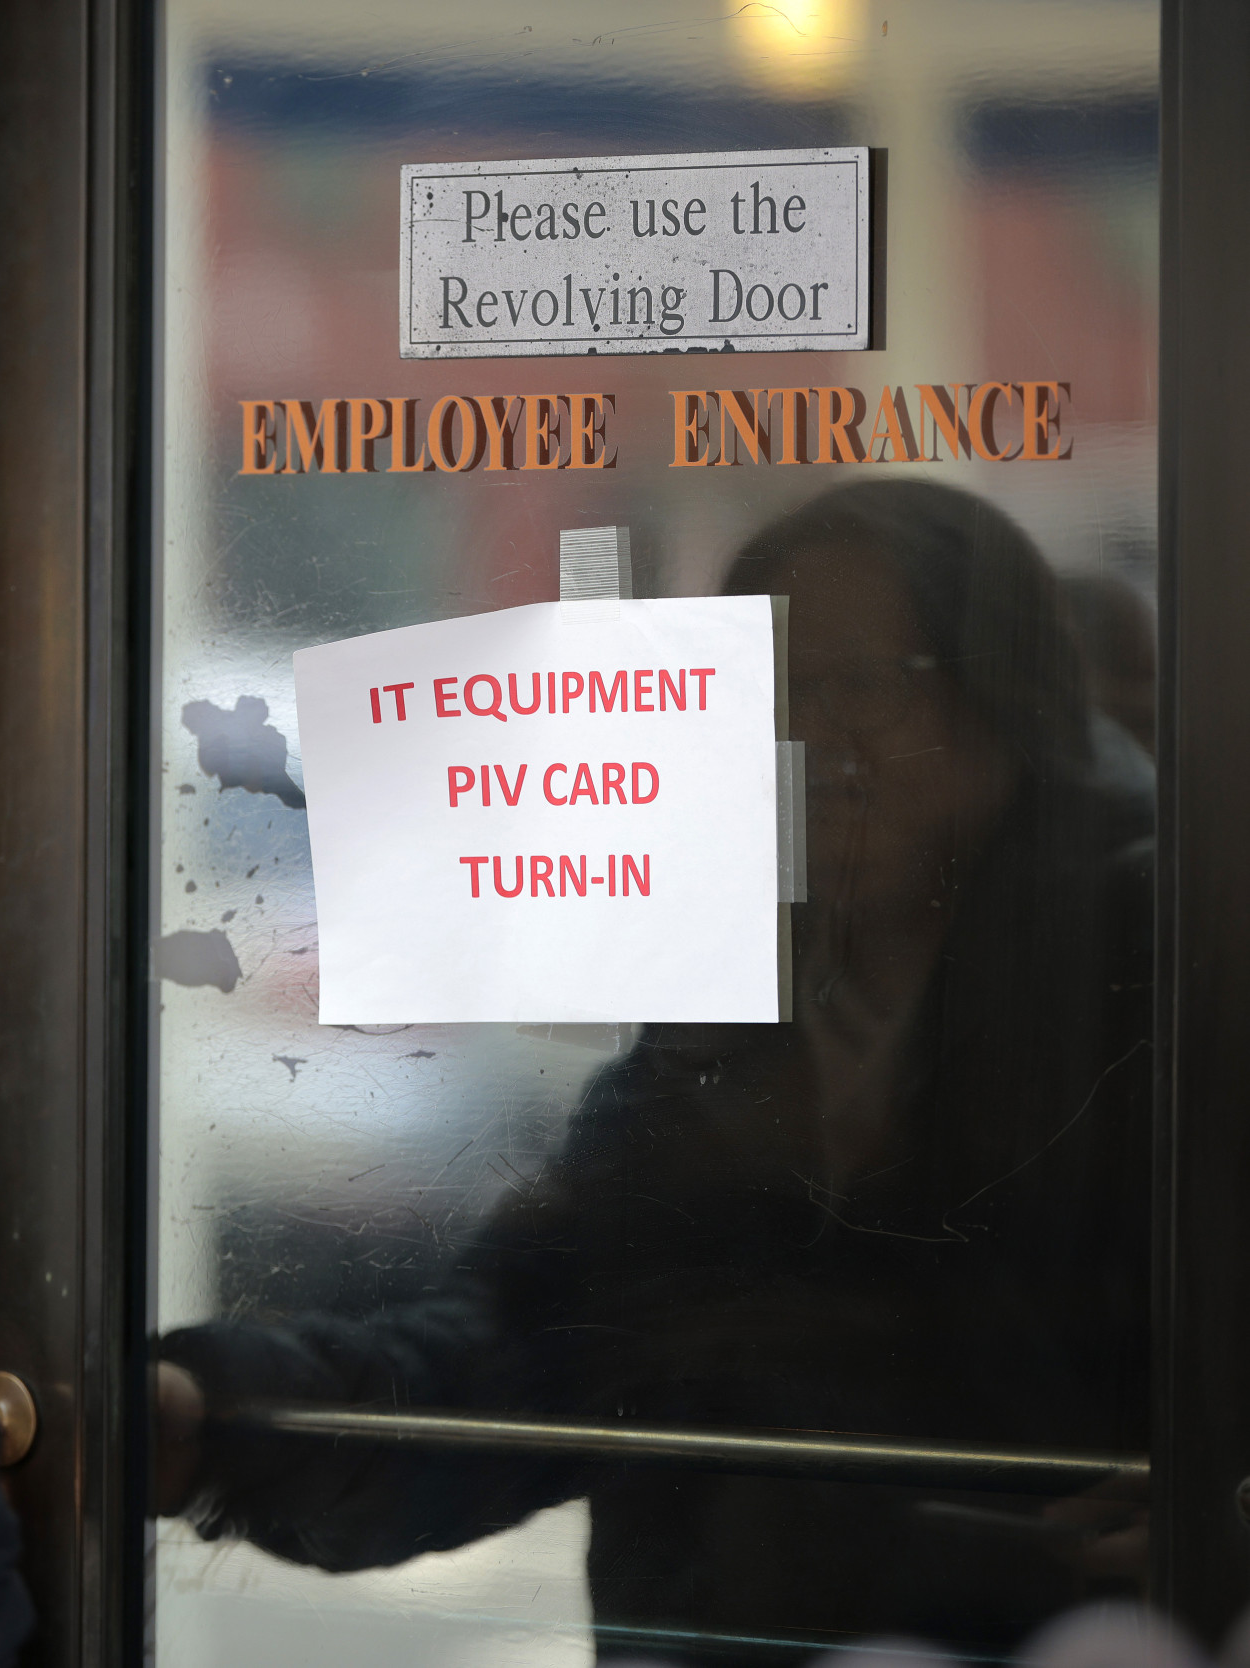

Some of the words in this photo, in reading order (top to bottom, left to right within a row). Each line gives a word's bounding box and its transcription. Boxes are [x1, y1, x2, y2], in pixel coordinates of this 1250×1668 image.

[462, 189, 606, 243] Please
[630, 197, 707, 238] use
[730, 180, 807, 235] the
[438, 275, 687, 336] Revolving
[708, 268, 829, 324] Door
[238, 393, 610, 475] EMPLOYEE
[668, 380, 1066, 467] ENTRANCE
[369, 682, 415, 724] IT
[433, 668, 716, 722] EQUIPMENT
[447, 763, 528, 808] PIV
[542, 761, 660, 806] CARD
[459, 853, 652, 899] TURN-IN
